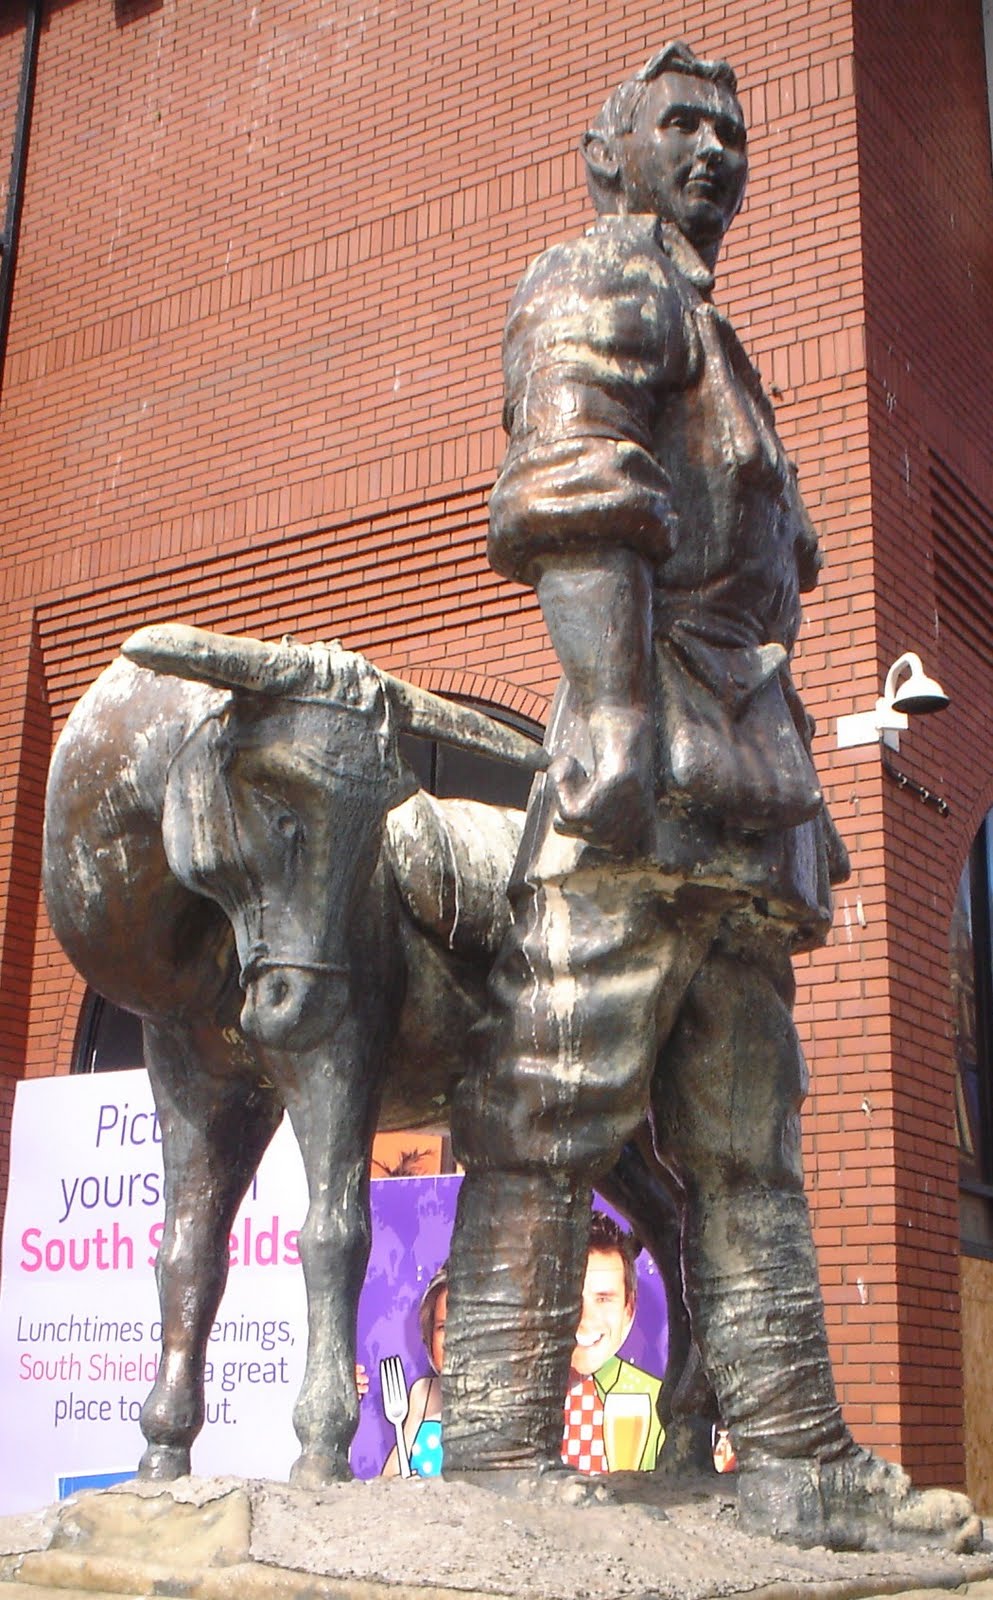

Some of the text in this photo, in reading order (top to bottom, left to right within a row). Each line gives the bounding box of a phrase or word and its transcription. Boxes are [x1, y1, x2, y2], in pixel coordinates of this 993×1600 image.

[96, 1103, 162, 1148] Pict
[59, 1171, 165, 1223] yours
[20, 1222, 133, 1272] South
[17, 1314, 143, 1342] Lunchtimes
[208, 1314, 295, 1351] enings,
[19, 1353, 81, 1381] South
[88, 1353, 158, 1382] Shield
[221, 1357, 290, 1392] great
[54, 1392, 237, 1427] place to ut.
